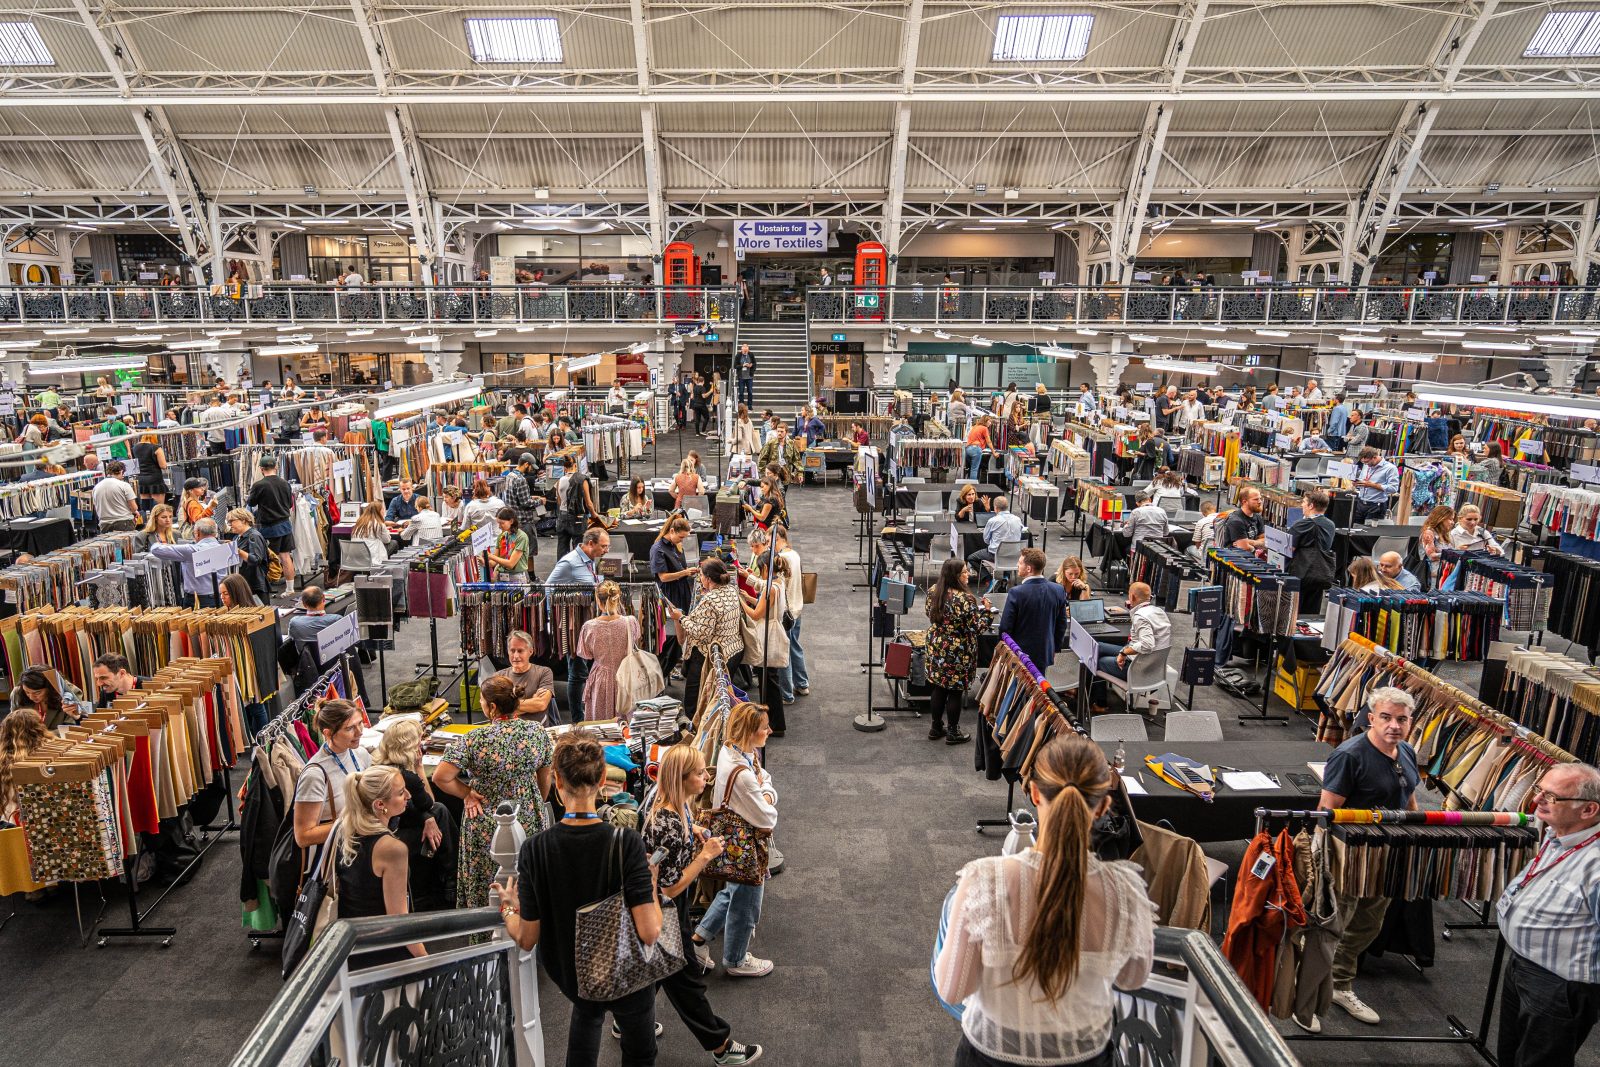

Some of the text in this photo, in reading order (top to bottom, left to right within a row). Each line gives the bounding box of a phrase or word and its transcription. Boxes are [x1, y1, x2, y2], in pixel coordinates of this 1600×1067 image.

[758, 225, 790, 234] Upstairs
[738, 237, 823, 248] More Textiles
[737, 249, 744, 258] U
[811, 344, 840, 352] OFFICE
[651, 373, 657, 385] H
[867, 466, 874, 495] K
[334, 633, 344, 642] Since
